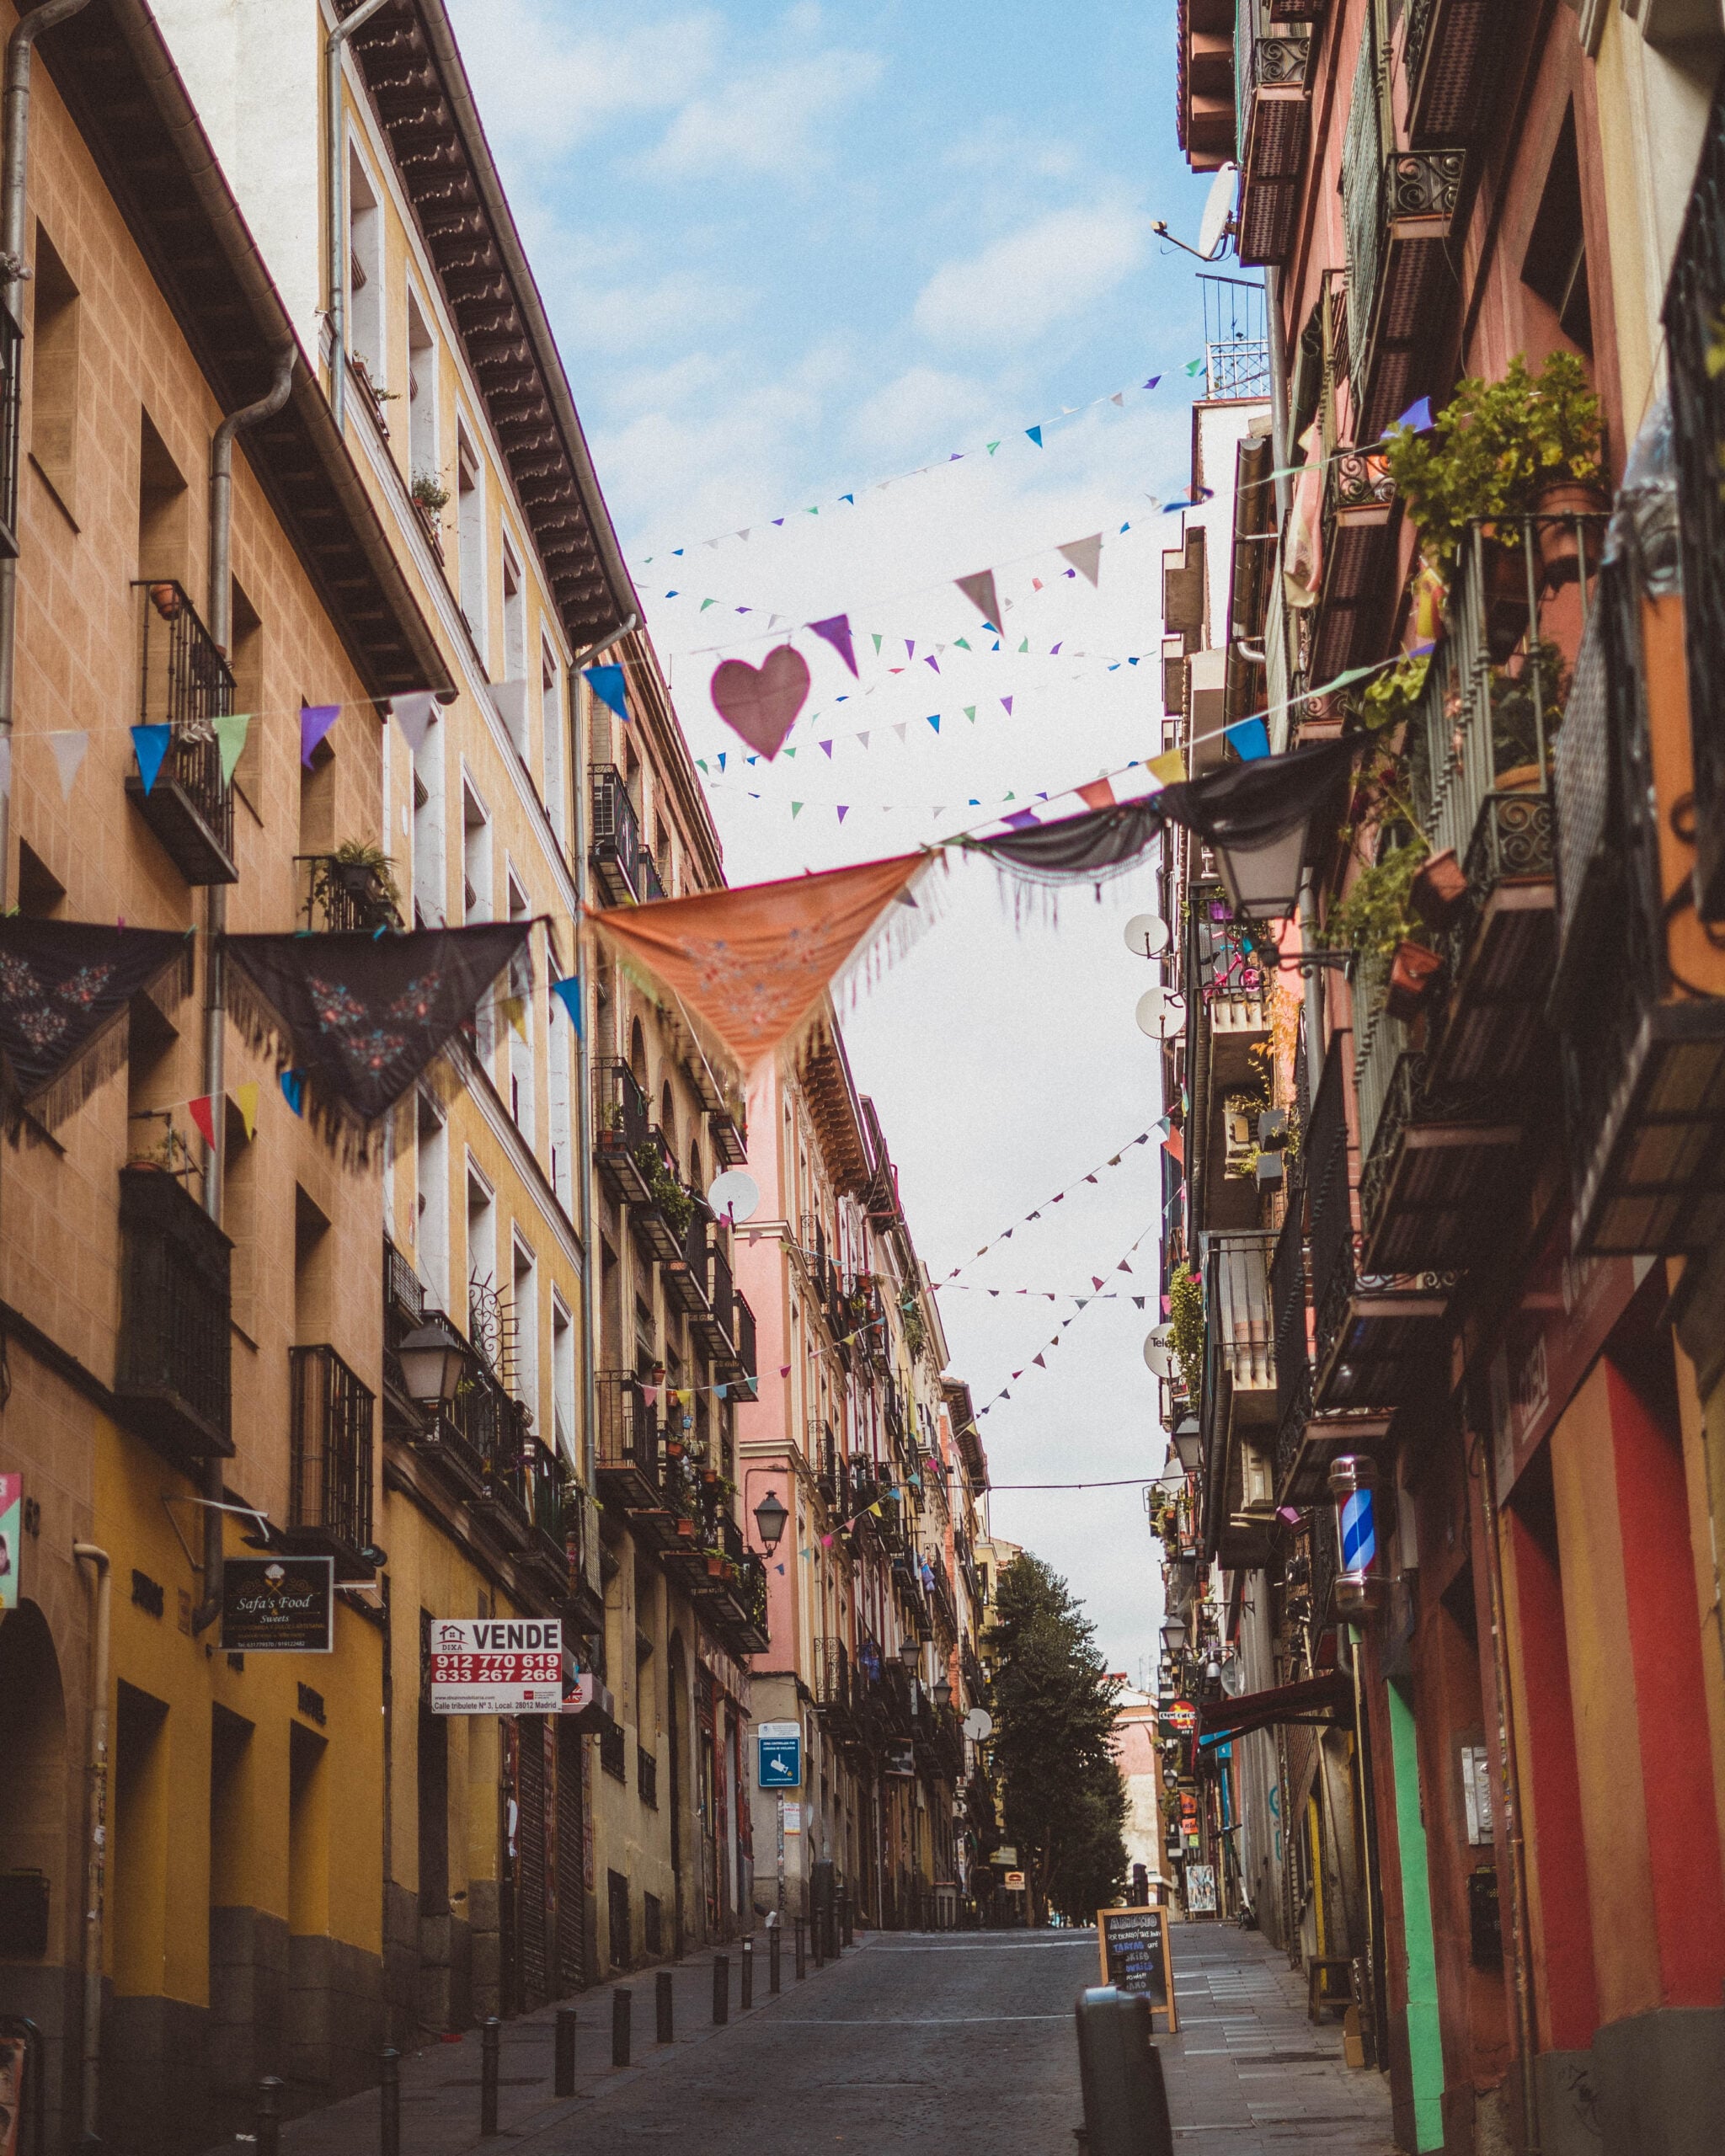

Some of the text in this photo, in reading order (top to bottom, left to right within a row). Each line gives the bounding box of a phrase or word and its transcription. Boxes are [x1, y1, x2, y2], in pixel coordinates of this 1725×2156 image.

[237, 1594, 313, 1613] Safa's Food
[259, 1614, 291, 1624] Sweets
[472, 1624, 558, 1650] VENDE
[436, 1655, 559, 1668] 912 770 619
[435, 1668, 558, 1682] 633 267 266
[1113, 1941, 1144, 1952] TARTAS
